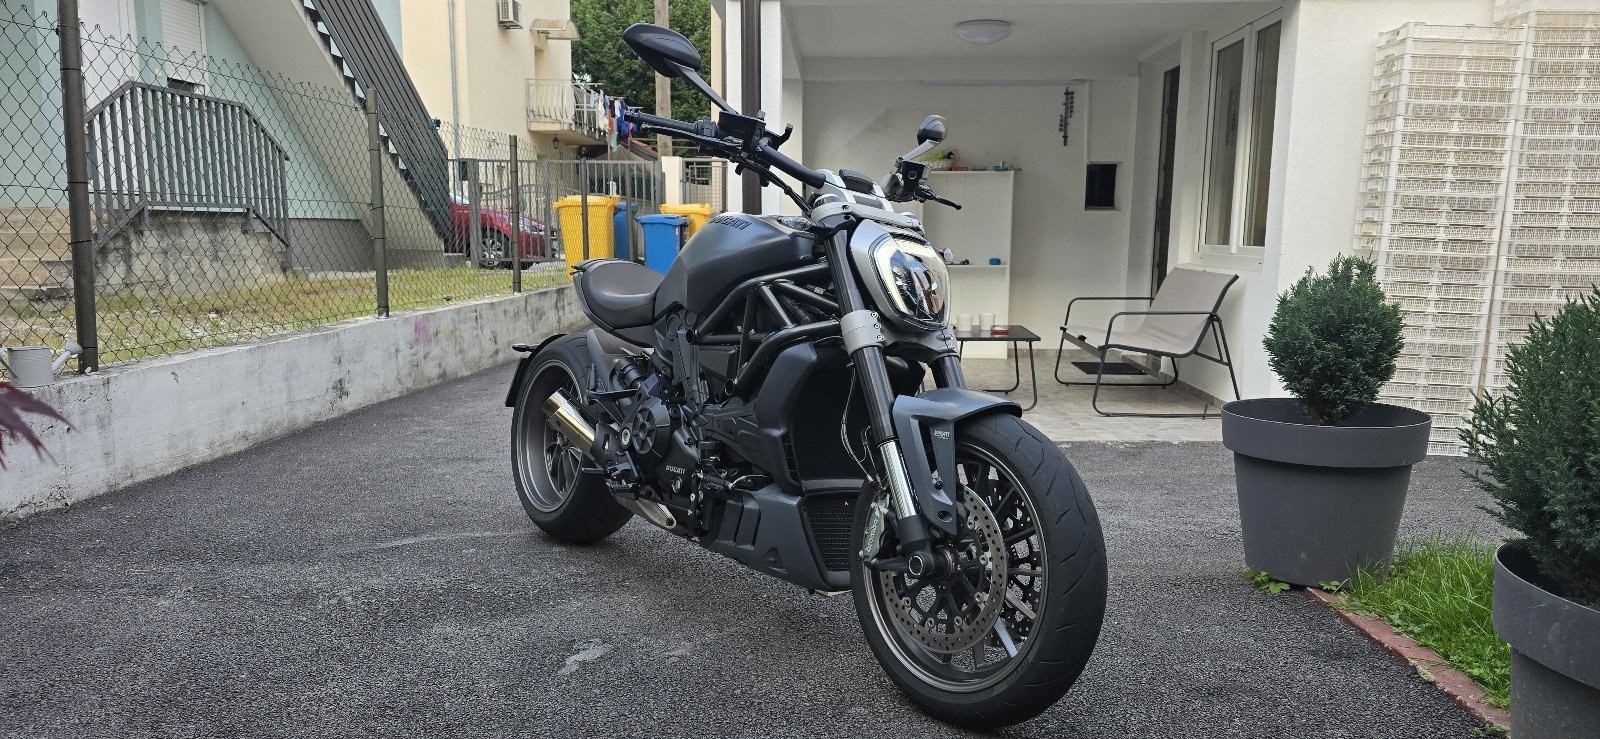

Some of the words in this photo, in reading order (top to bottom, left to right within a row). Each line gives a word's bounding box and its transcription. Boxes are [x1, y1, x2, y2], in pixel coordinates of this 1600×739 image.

[707, 215, 753, 230] DUCATI
[665, 465, 686, 475] DUCATI
[864, 519, 878, 553] brembo
